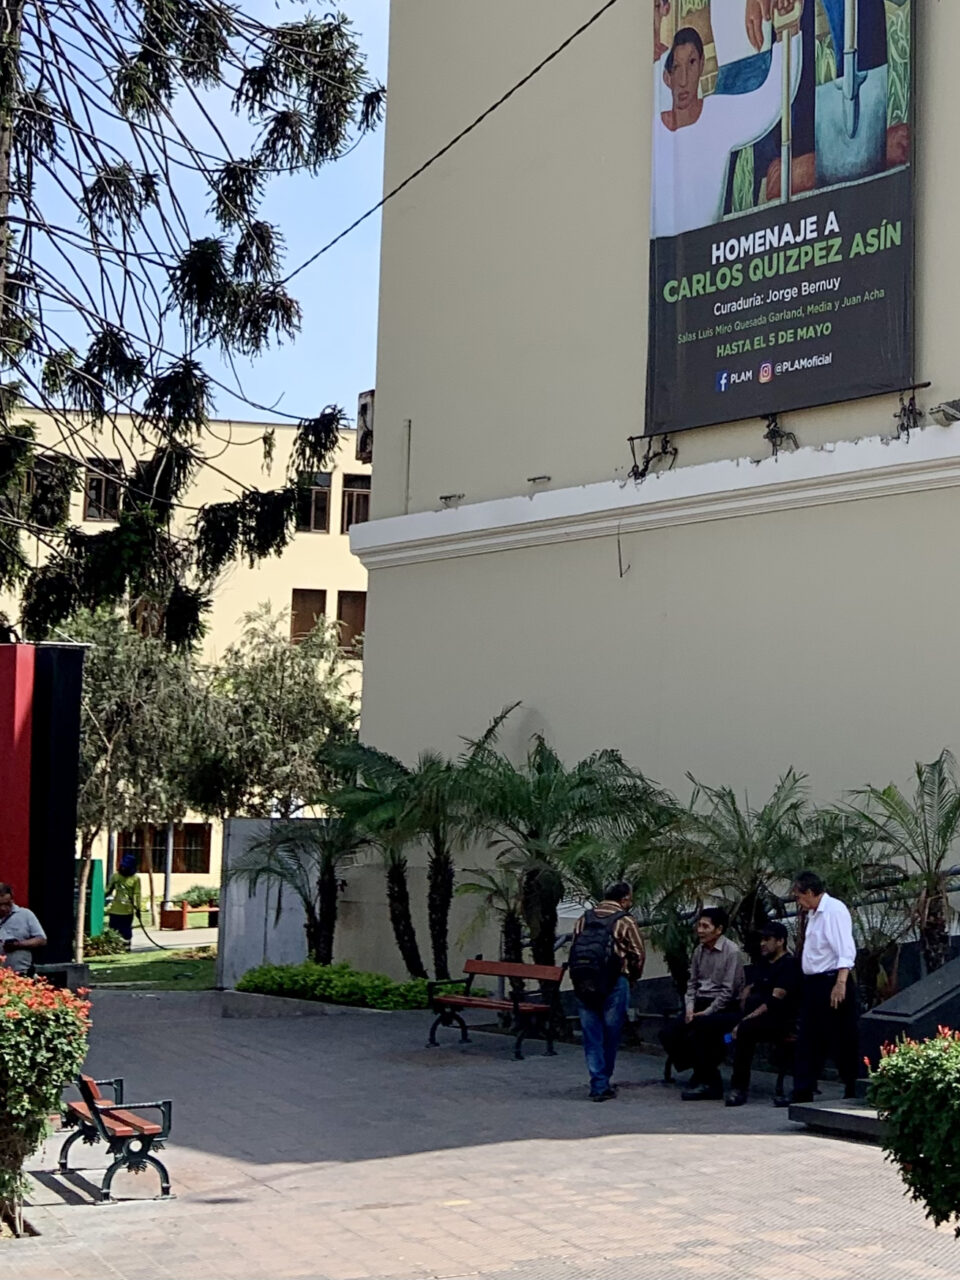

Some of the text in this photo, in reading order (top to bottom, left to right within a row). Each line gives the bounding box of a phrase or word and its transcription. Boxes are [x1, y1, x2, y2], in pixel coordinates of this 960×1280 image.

[711, 210, 840, 265] HOMENAJE A
[662, 219, 902, 303] CARLOS QUIZPEZ ASÍN
[766, 286, 798, 303] Jorge
[801, 276, 841, 296] Bernuy
[677, 288, 885, 344] Salas Luis Miró Quesada Garland, Media y Juan Acha
[716, 322, 832, 358] HASTA EL 5 DE MAYO
[730, 352, 832, 384] PLAM @PLAMoficial
